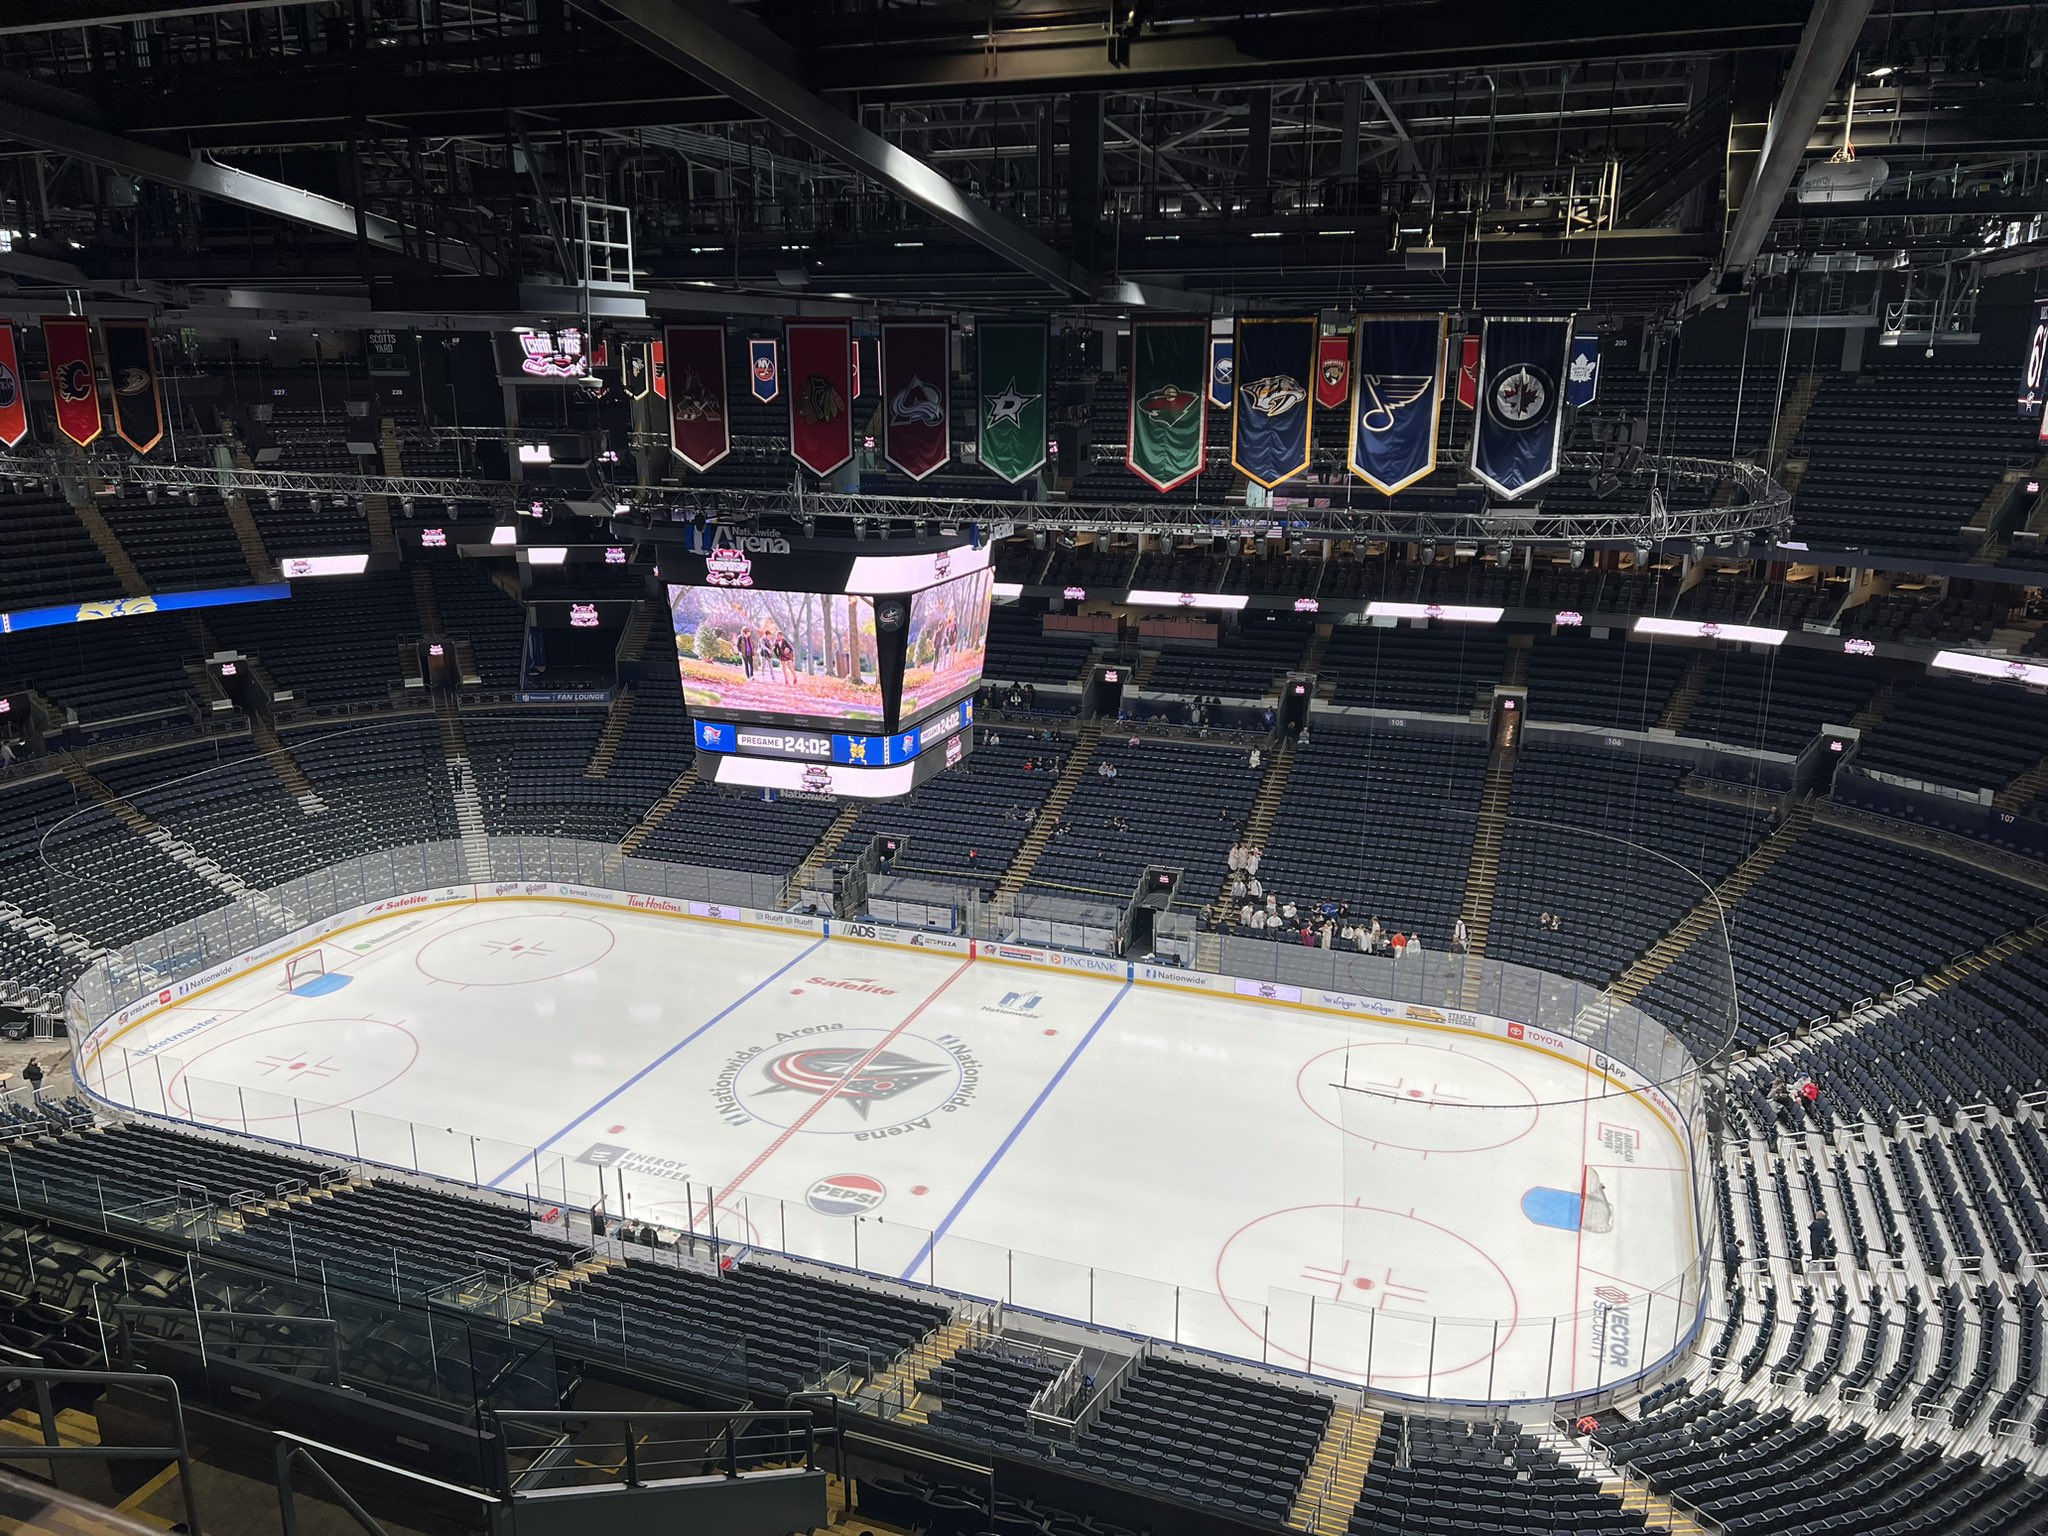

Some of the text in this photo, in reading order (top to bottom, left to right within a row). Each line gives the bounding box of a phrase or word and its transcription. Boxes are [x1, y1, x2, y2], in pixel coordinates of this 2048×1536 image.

[369, 334, 397, 344] SCOTTS
[374, 343, 394, 353] YARD
[711, 525, 791, 554] Arena
[940, 711, 960, 735] 24:02
[1391, 719, 1404, 727] 105
[741, 736, 831, 756] PREGAME 24:02
[1608, 738, 1622, 746] 106
[779, 788, 838, 803] Nationwide
[2000, 813, 2015, 824] 107
[569, 888, 588, 897] bread
[386, 895, 428, 910] Safelite
[627, 894, 682, 913] Tim Hortons
[764, 913, 784, 923] Ruoff
[794, 917, 814, 927] Ruoff
[849, 924, 876, 939] ADS
[937, 939, 957, 948] PIZZA
[1063, 956, 1117, 973] PNC BANK
[189, 966, 233, 990] Nationwide
[806, 976, 896, 996] Safelite
[1158, 971, 1206, 985] Nationwide
[129, 998, 159, 1017] STREAM ON
[980, 1005, 1040, 1020] Nationwide
[1332, 996, 1395, 1016] Kroger Kroger
[1447, 1012, 1478, 1023] STANLEY
[132, 1014, 220, 1057] ticketmaster
[1527, 1031, 1564, 1049] TOYOTA
[709, 1022, 844, 1116] Nationwide Arena
[854, 1043, 983, 1142] Nationwide Arena
[1651, 1091, 1677, 1123] Safelite
[624, 1152, 688, 1170] ENERGY
[617, 1160, 691, 1182] TRANSFER
[812, 1184, 880, 1206] PEPSI
[1591, 1300, 1607, 1362] SECURITY
[1610, 1306, 1630, 1368] VECTOR
